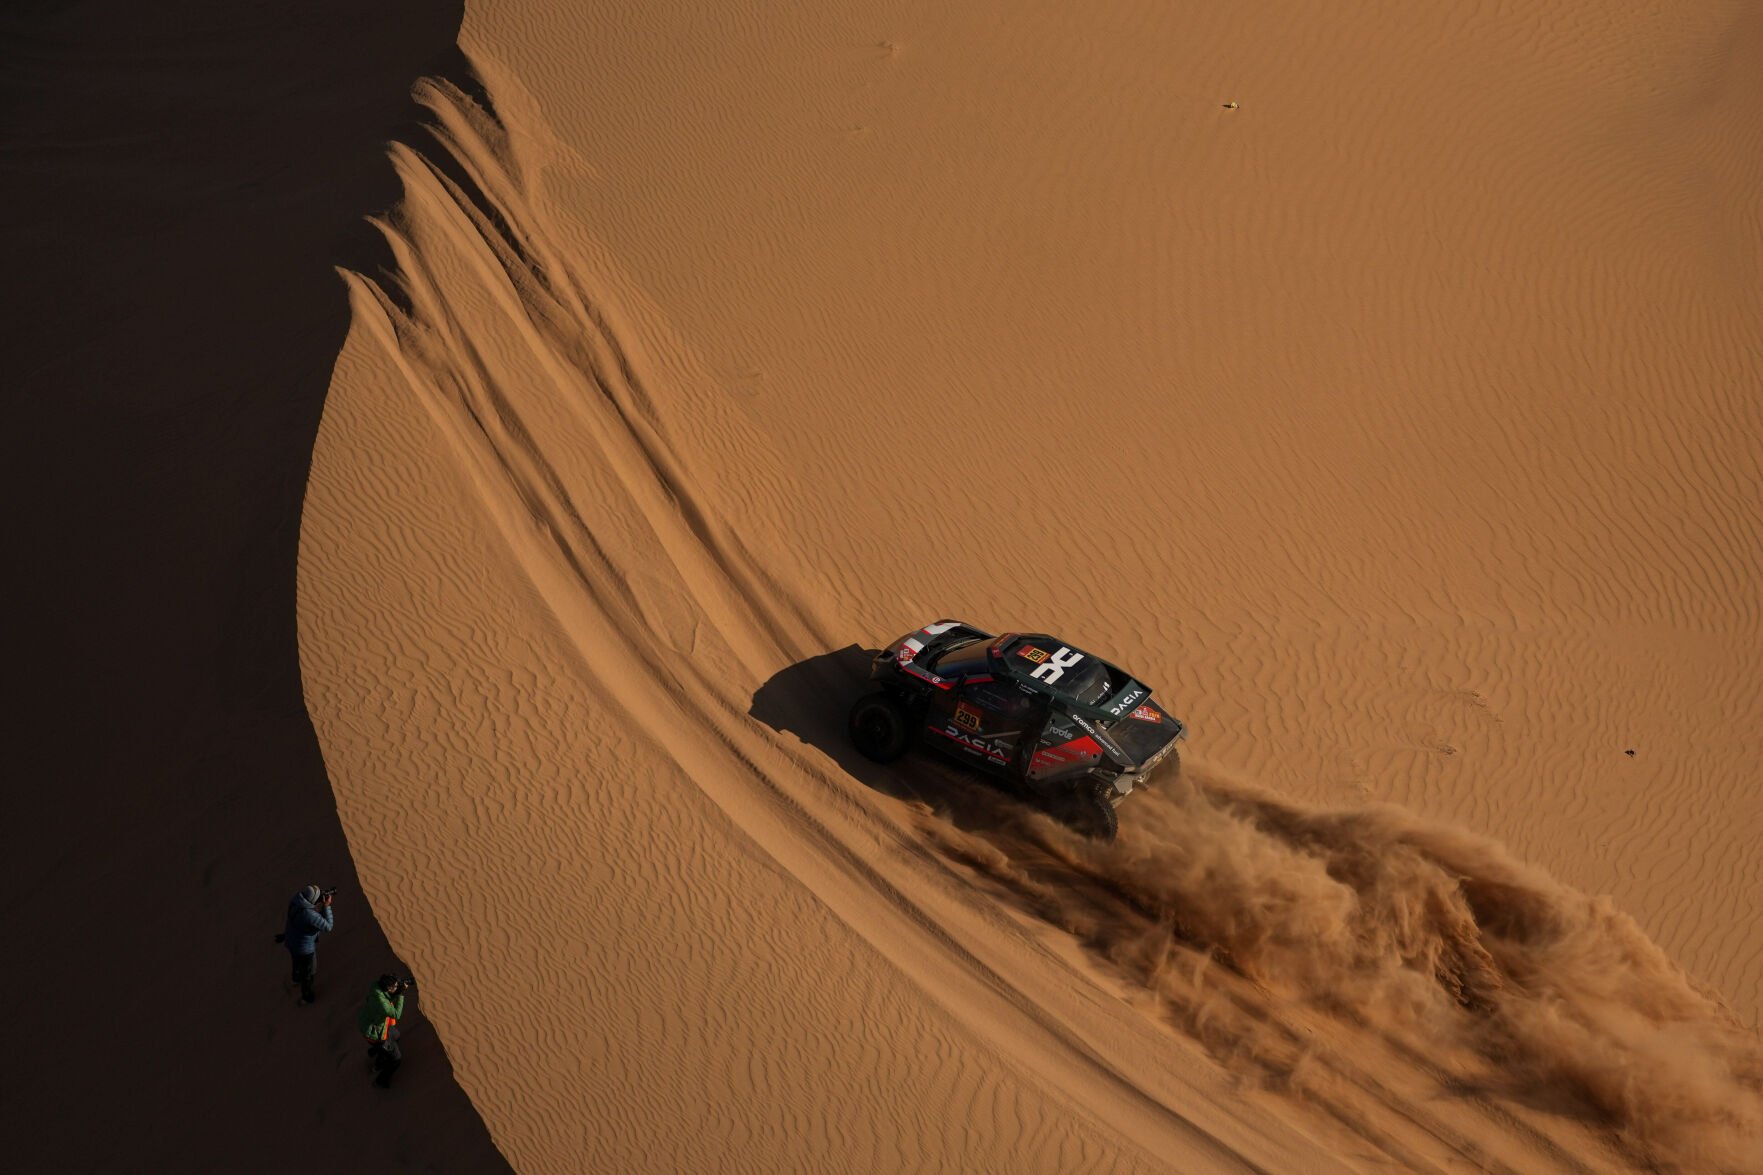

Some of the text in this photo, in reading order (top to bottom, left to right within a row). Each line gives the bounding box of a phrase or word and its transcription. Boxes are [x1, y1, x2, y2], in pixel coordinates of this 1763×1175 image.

[1110, 690, 1143, 716] DACIA
[956, 710, 977, 728] 299
[1072, 714, 1095, 734] aramco
[944, 724, 1005, 758] DACIA
